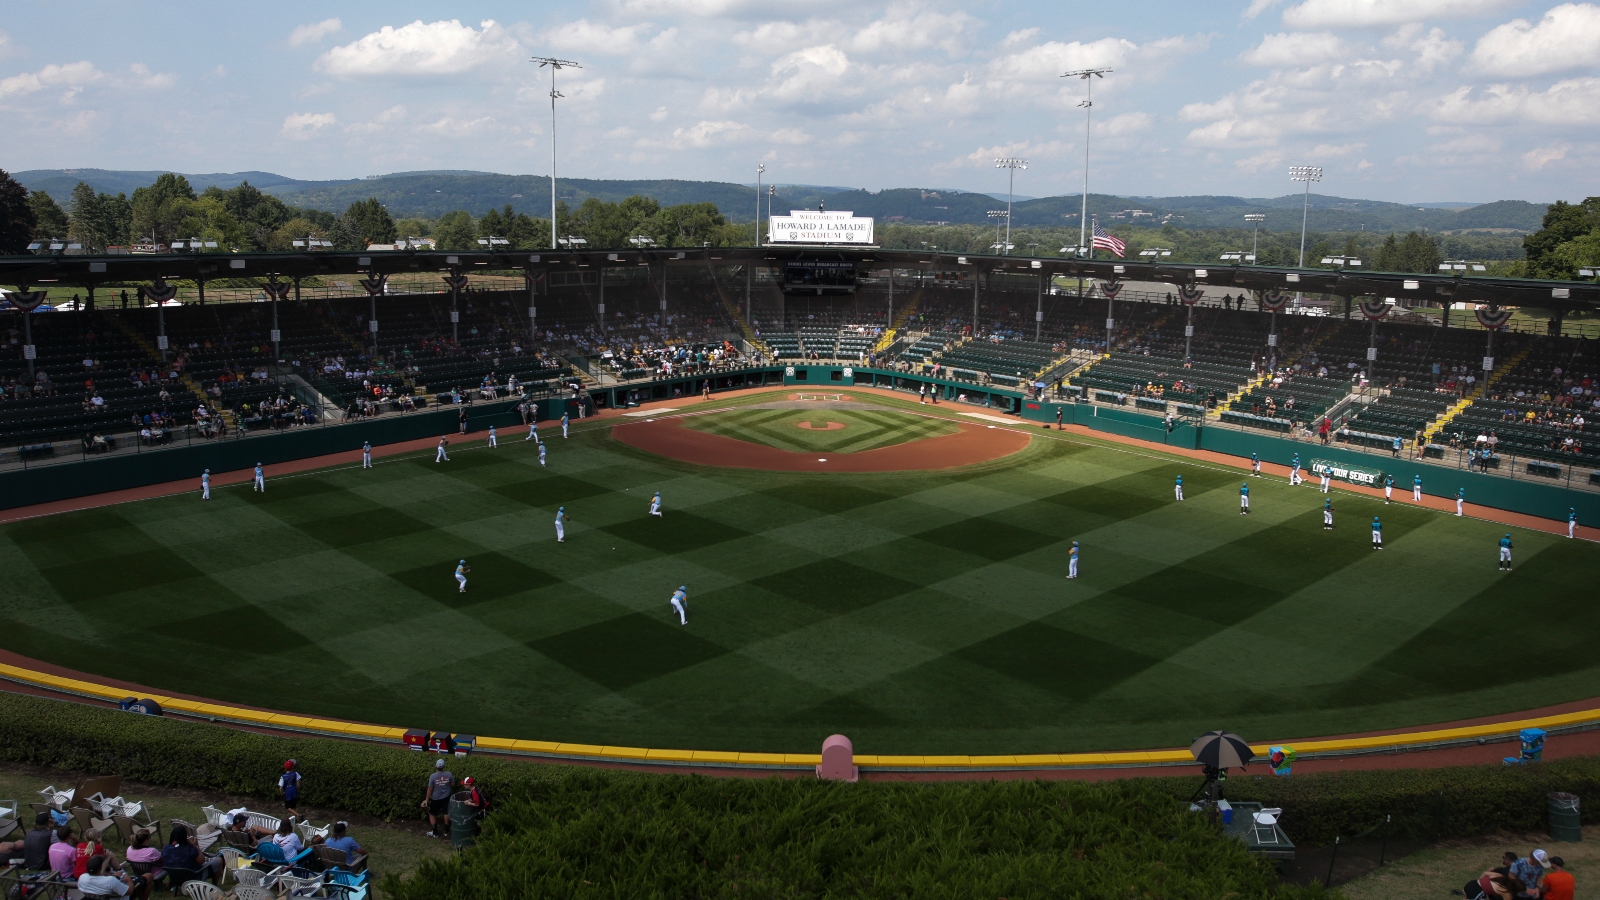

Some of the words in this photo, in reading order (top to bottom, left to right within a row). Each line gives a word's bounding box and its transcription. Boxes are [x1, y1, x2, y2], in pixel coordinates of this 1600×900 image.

[777, 222, 816, 230] HOWARD
[819, 223, 824, 231] J.
[827, 223, 867, 231] LAMADE
[1349, 470, 1375, 484] SERIES
